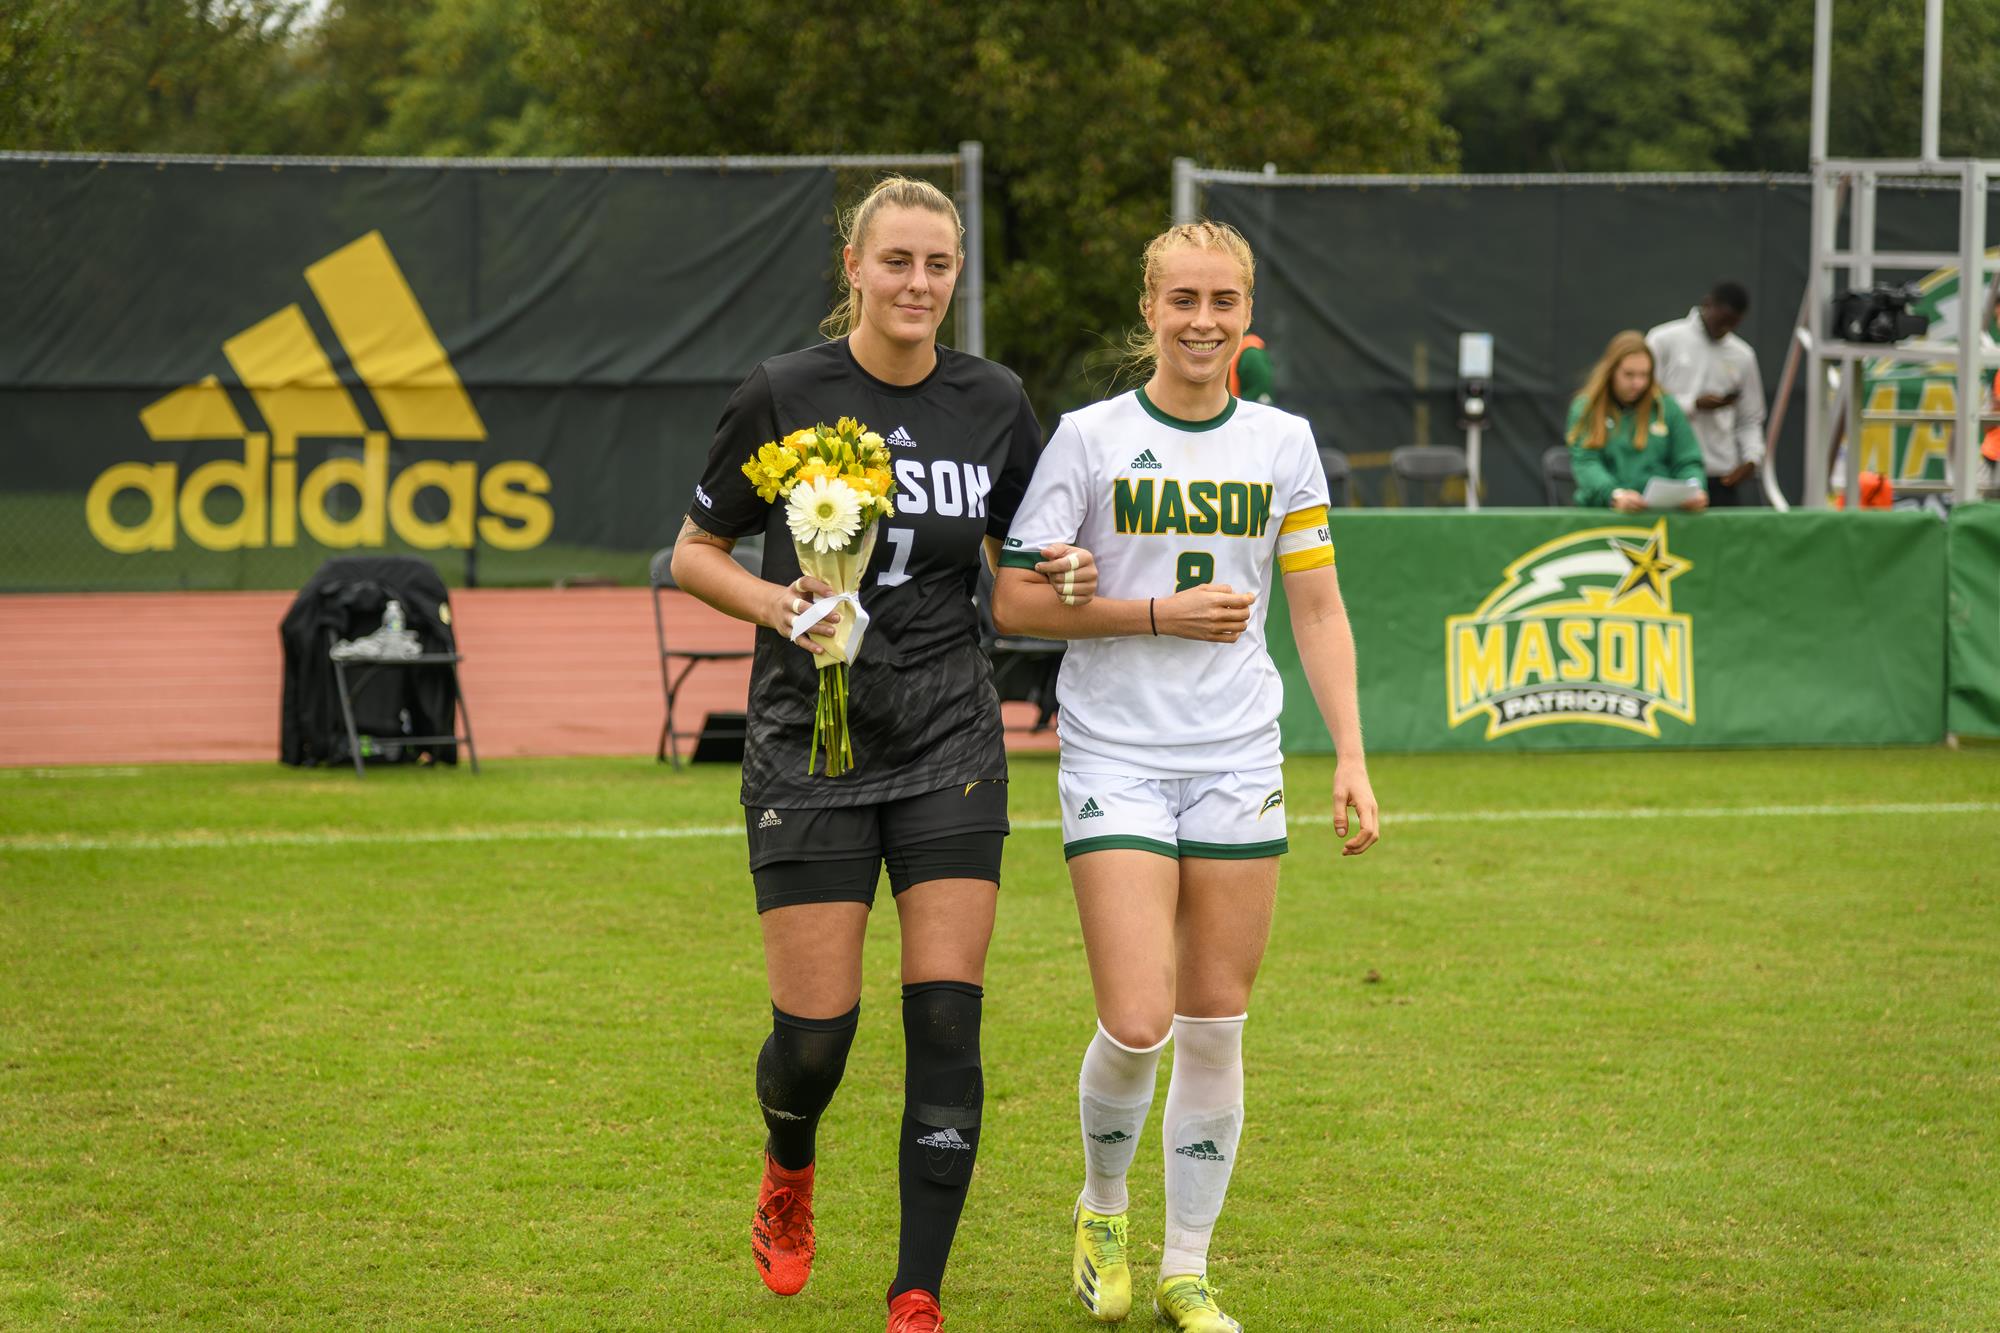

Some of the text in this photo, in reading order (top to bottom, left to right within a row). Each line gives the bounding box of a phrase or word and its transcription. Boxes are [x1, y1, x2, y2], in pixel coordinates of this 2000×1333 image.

[886, 436, 917, 448] adidas
[1130, 460, 1163, 470] adidas
[86, 431, 555, 554] adidas
[895, 459, 992, 518] SON
[1113, 477, 1273, 539] MASON
[877, 527, 915, 587] 1
[1457, 618, 1684, 706] MASON
[1502, 691, 1642, 720] PATRIOTS
[1077, 809, 1105, 820] adidas
[916, 1138, 971, 1150] adidas
[1175, 1147, 1226, 1162] adidas
